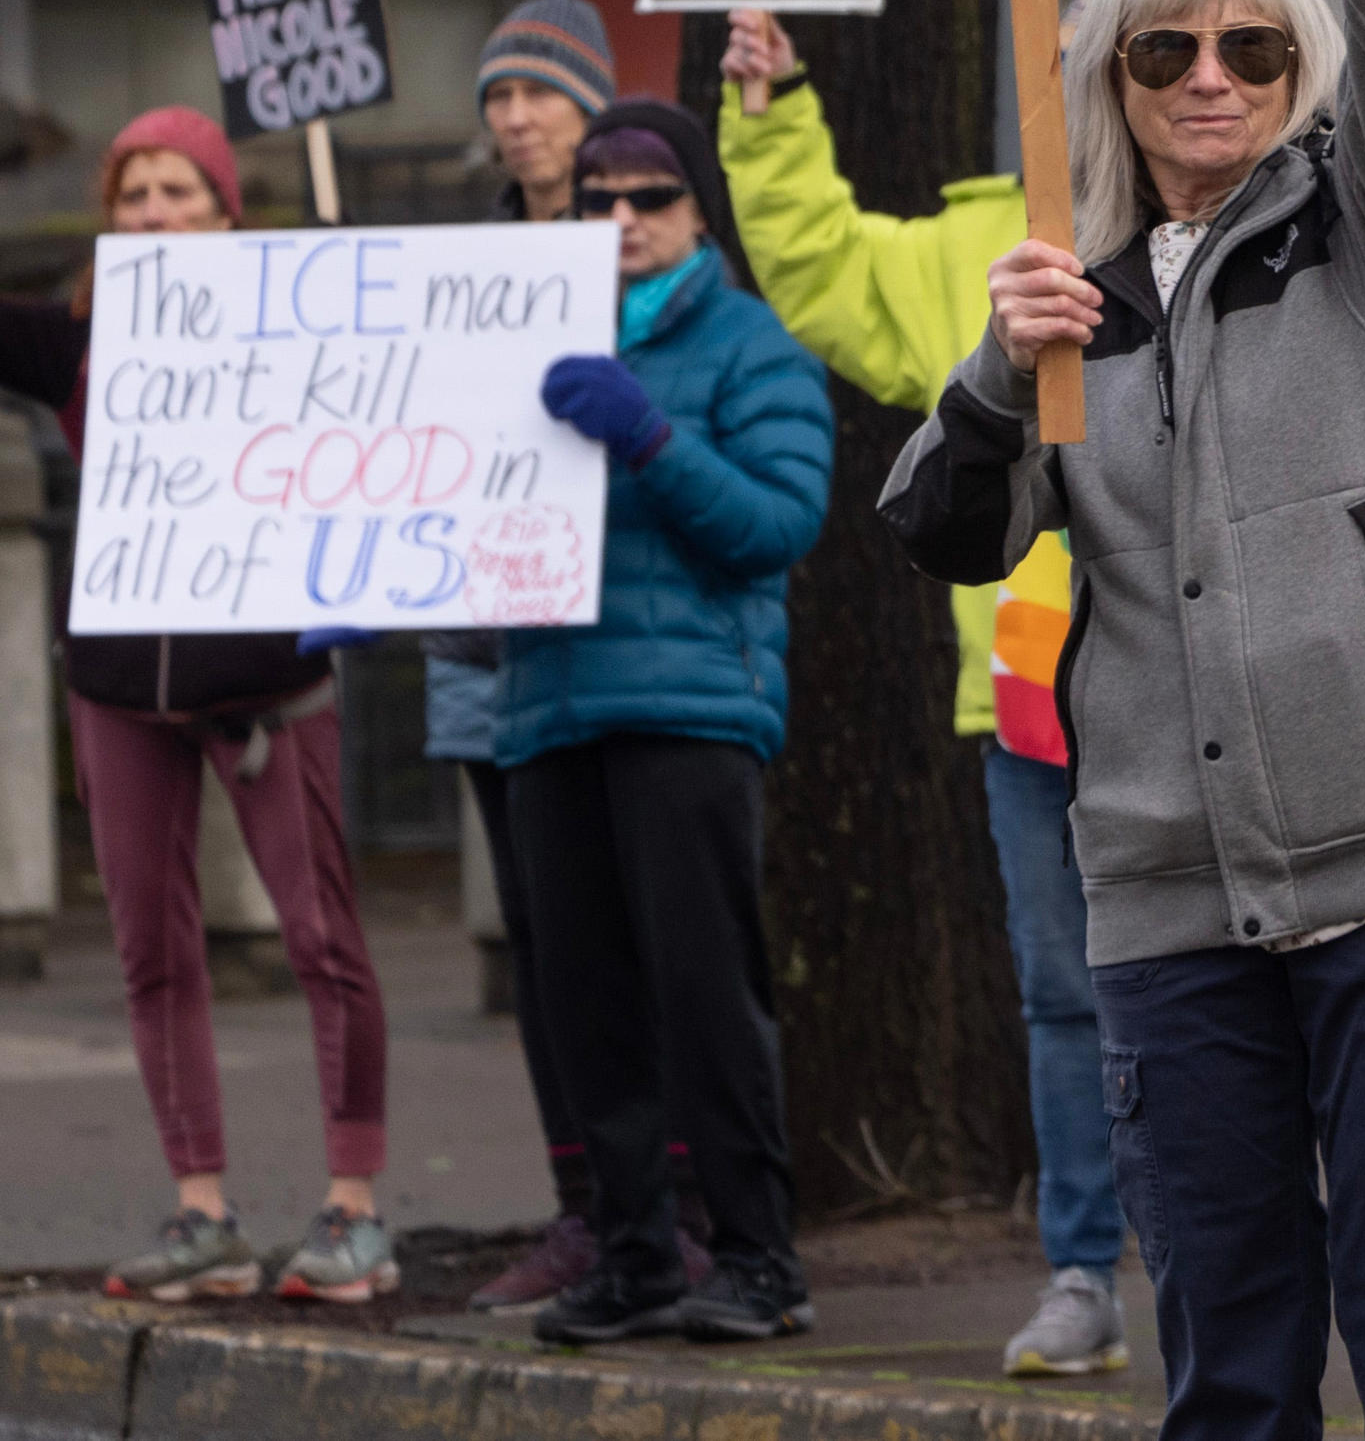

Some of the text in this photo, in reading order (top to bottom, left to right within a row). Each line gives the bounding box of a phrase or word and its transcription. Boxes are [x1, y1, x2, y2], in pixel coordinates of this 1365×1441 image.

[246, 43, 385, 130] GOOD
[105, 237, 572, 341] The ICE man
[104, 339, 422, 424] can't kill
[96, 423, 541, 510] the GOOD in
[84, 509, 468, 617] all of US
